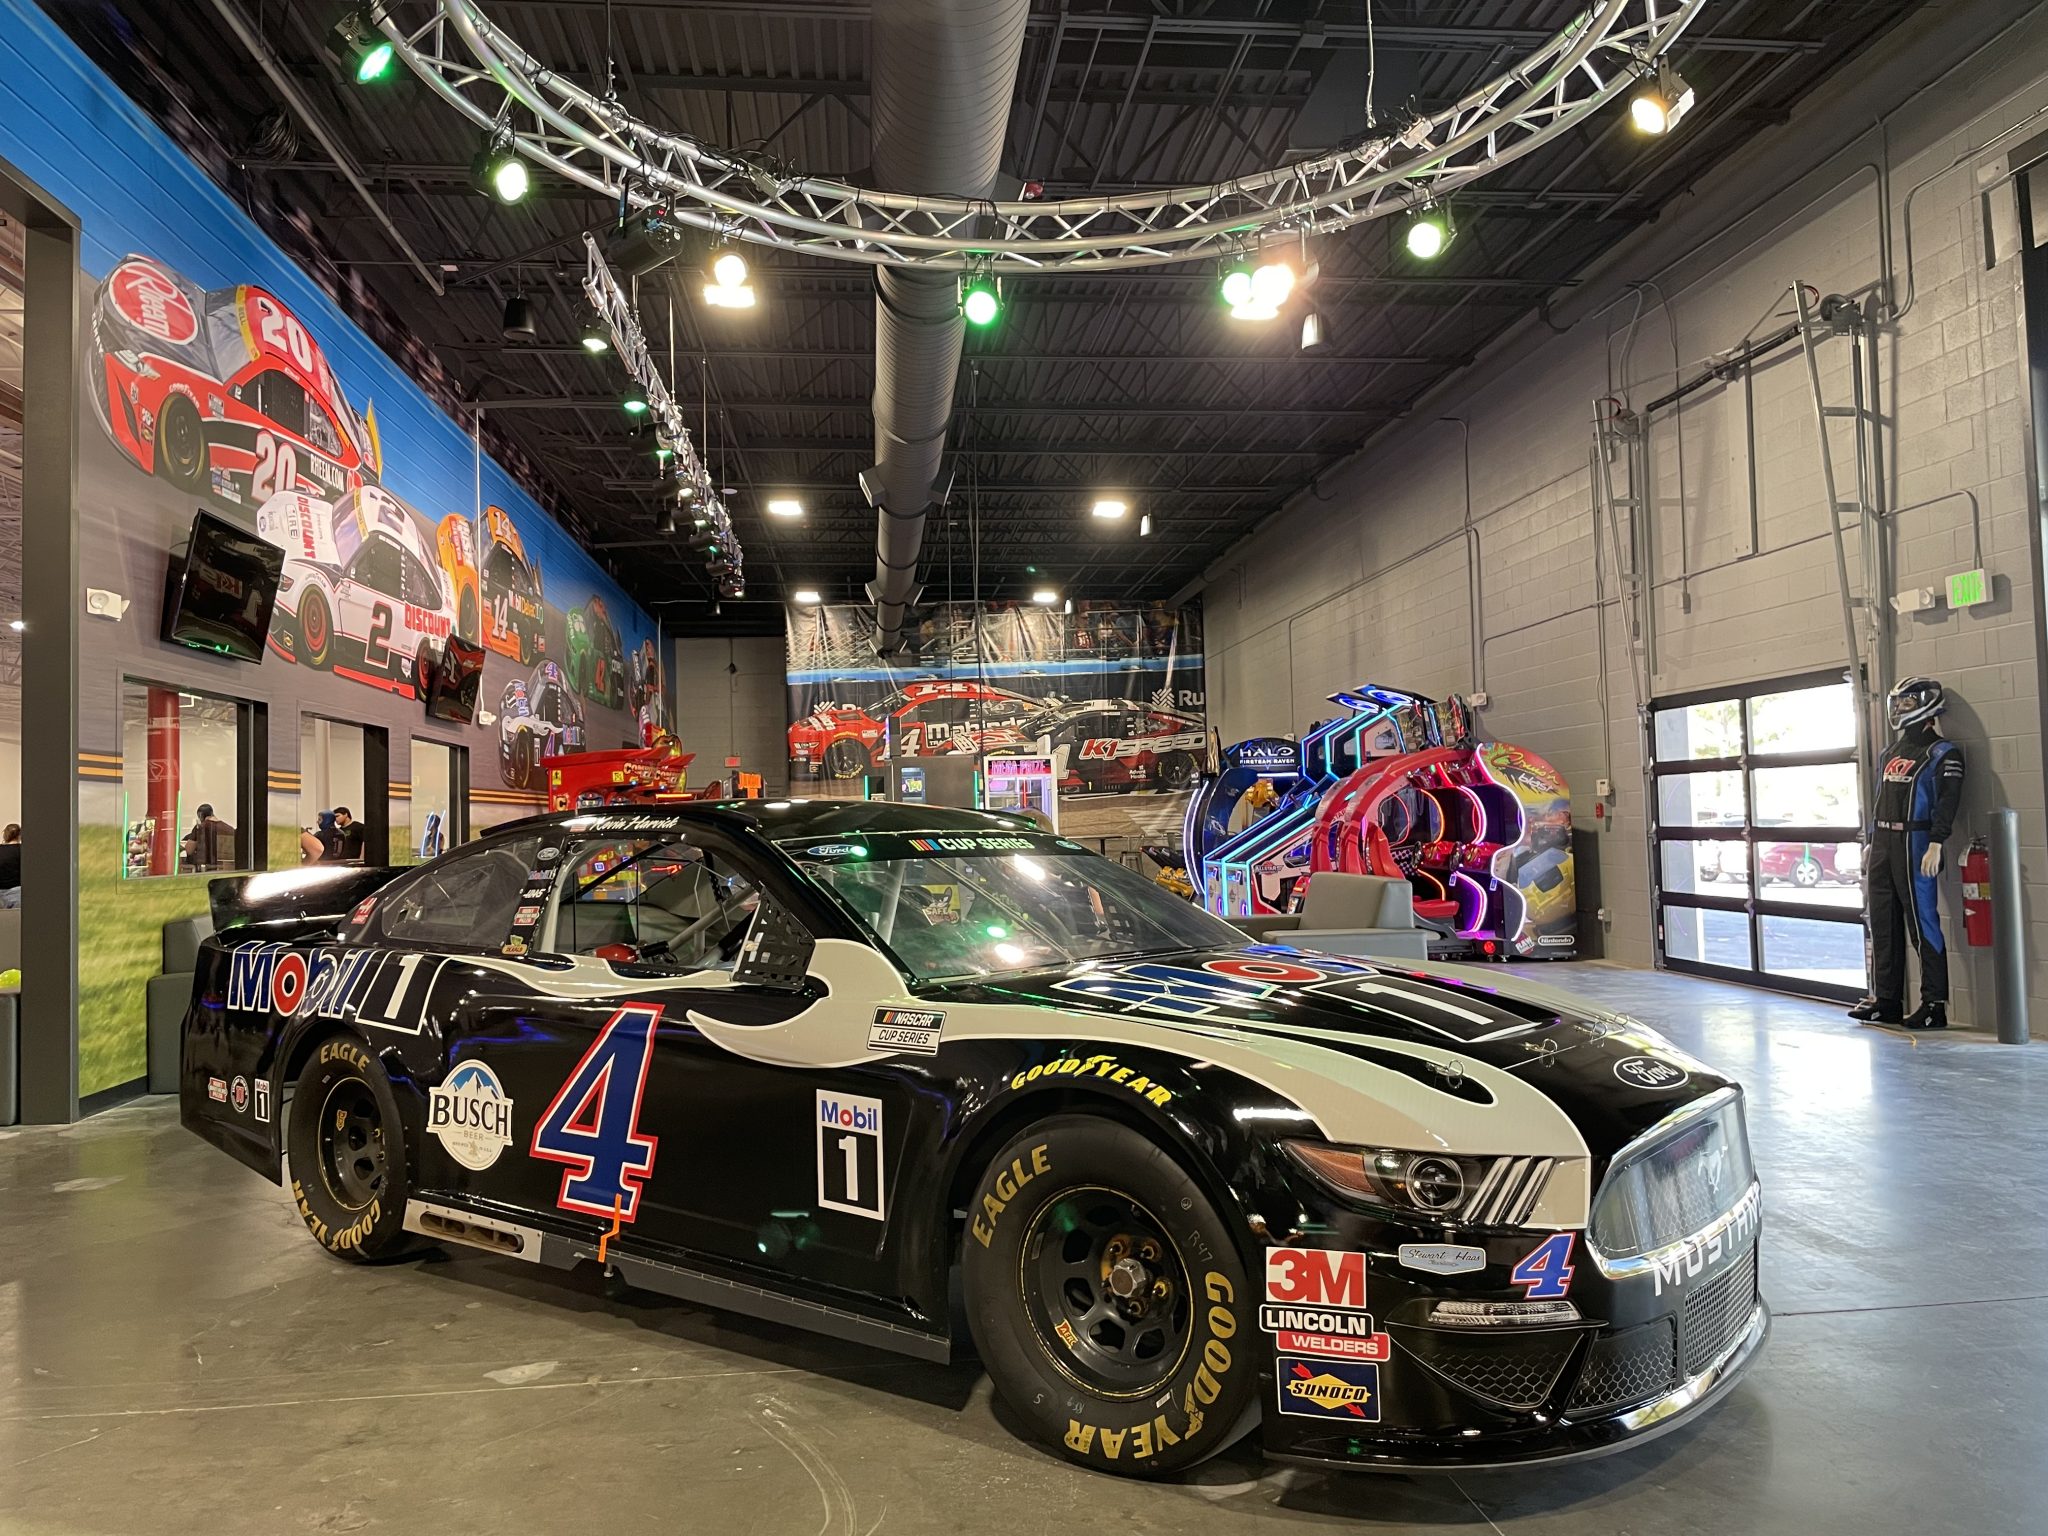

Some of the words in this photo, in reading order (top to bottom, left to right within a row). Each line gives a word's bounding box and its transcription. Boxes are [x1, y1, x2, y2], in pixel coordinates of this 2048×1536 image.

[122, 267, 193, 337] Rheem
[256, 296, 313, 374] 20
[251, 429, 297, 503] 20
[310, 453, 344, 493] RHEEM.COM
[297, 496, 316, 559] DISCOUNT
[495, 511, 512, 542] 14
[1951, 571, 1980, 607] EXIT
[404, 605, 451, 639] DISCOUNT
[492, 594, 508, 640] 14
[365, 600, 393, 669] 2
[545, 661, 558, 680] 4
[915, 683, 960, 697] 14
[1240, 746, 1295, 757] HALO
[589, 816, 627, 831] Kevin
[623, 815, 680, 831] Harvick
[1878, 820, 1890, 829] USA
[818, 845, 850, 855] Ford
[938, 838, 977, 850] CUP
[975, 838, 1035, 850] SERIES
[1541, 937, 1572, 945] Nintendo
[227, 941, 379, 1019] Mobil
[384, 953, 424, 1019] 1
[894, 1012, 935, 1027] NASCAR
[878, 1029, 898, 1041] CUP
[897, 1031, 930, 1044] SERIES
[320, 1042, 370, 1073] EAGLE
[1622, 1059, 1679, 1085] Ford
[1011, 1055, 1173, 1108] GOODYEAR
[259, 1092, 266, 1118] 1
[432, 1094, 509, 1137] BUSCH
[529, 1001, 666, 1223] 4
[821, 1100, 878, 1132] Mobil
[463, 1130, 484, 1141] BEER
[838, 1134, 859, 1201] 1
[971, 1144, 1053, 1249] EAGLE
[292, 1179, 381, 1250] GOODYEAR
[1649, 1180, 1762, 1297] MUSTAN
[1407, 1249, 1447, 1260] Stewart
[1455, 1251, 1482, 1262] Haas
[1510, 1231, 1577, 1300] 4
[1267, 1249, 1366, 1307] 3M
[1265, 1309, 1367, 1336] LINCOLN
[1291, 1334, 1379, 1355] WELDERS
[1064, 1270, 1237, 1460] GOODYEAR
[1292, 1381, 1367, 1401] SUNOCO
